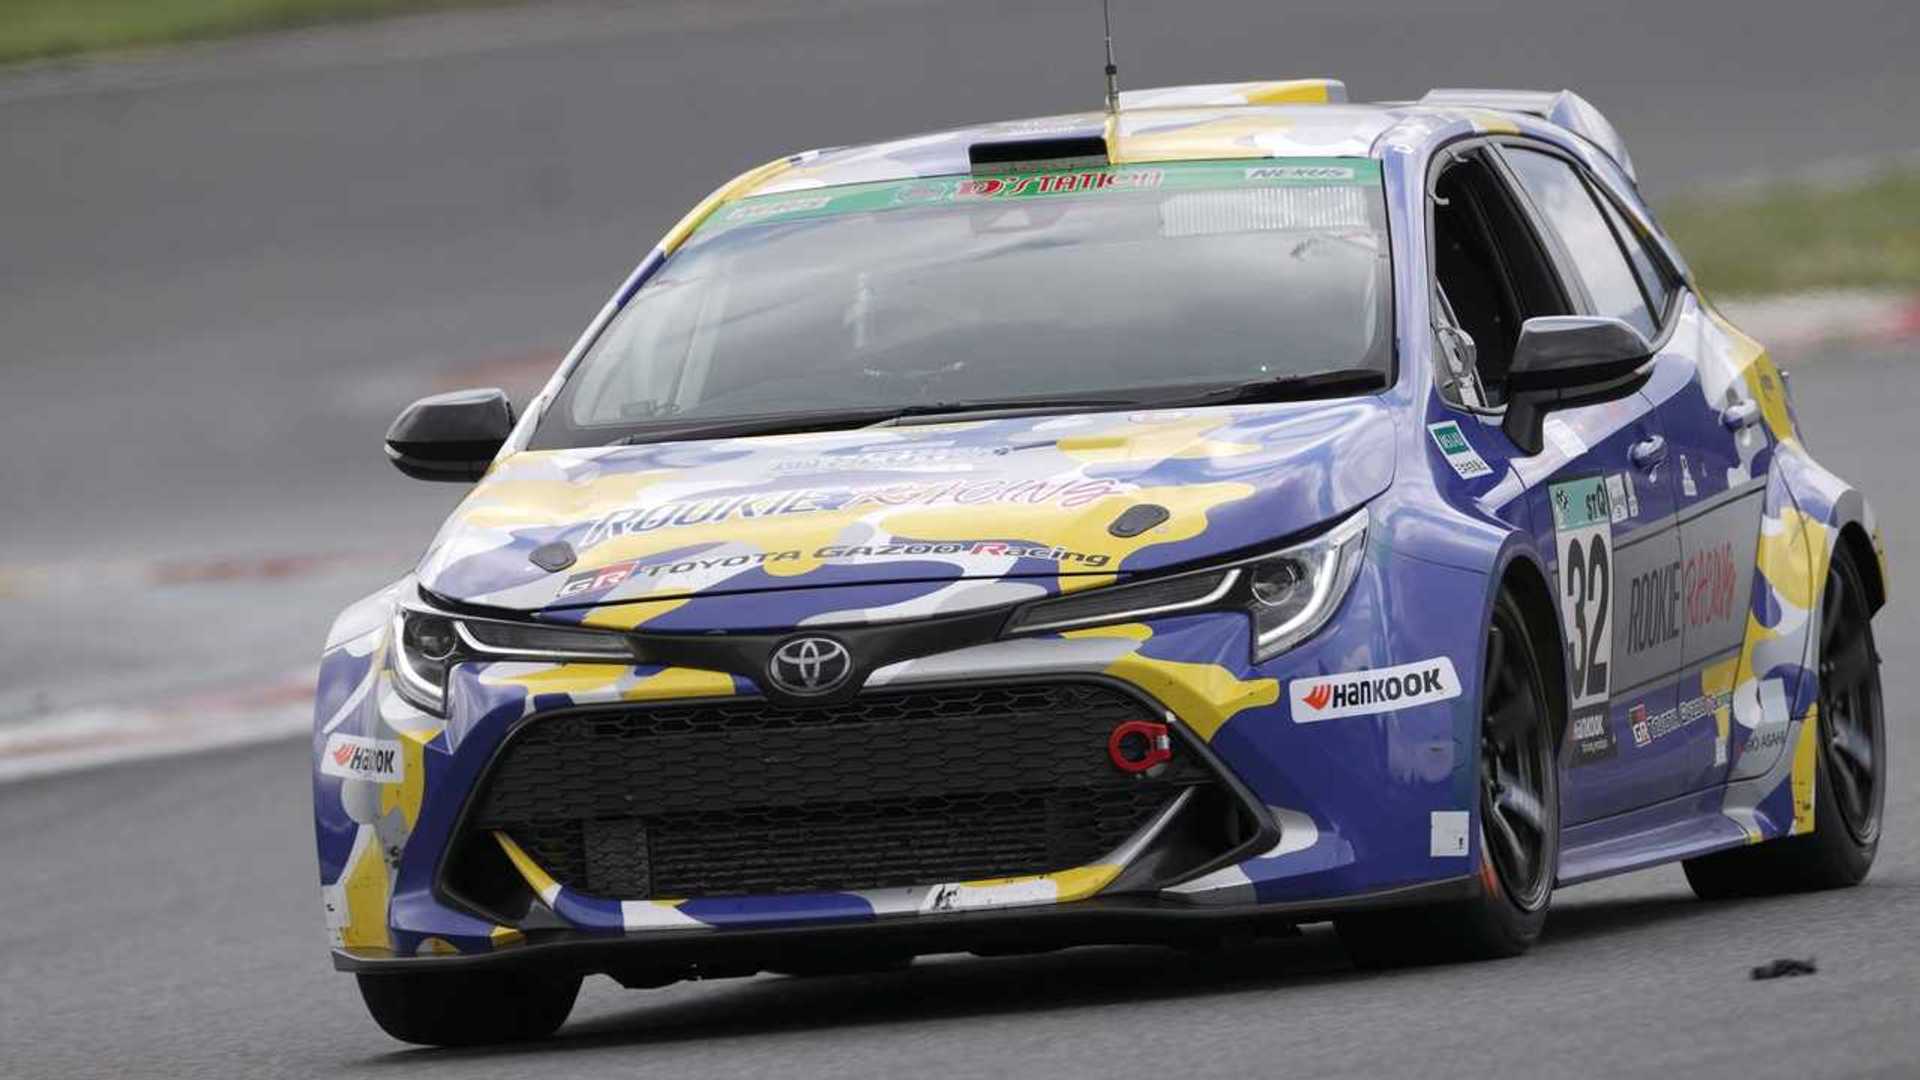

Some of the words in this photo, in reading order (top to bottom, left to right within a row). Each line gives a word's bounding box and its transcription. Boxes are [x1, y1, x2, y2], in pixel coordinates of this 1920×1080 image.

[645, 551, 801, 577] TOYOTA
[813, 543, 961, 559] GAZOO
[970, 542, 1110, 567] Racing
[1566, 533, 1609, 700] 32
[1627, 561, 1680, 655] ROOKIE
